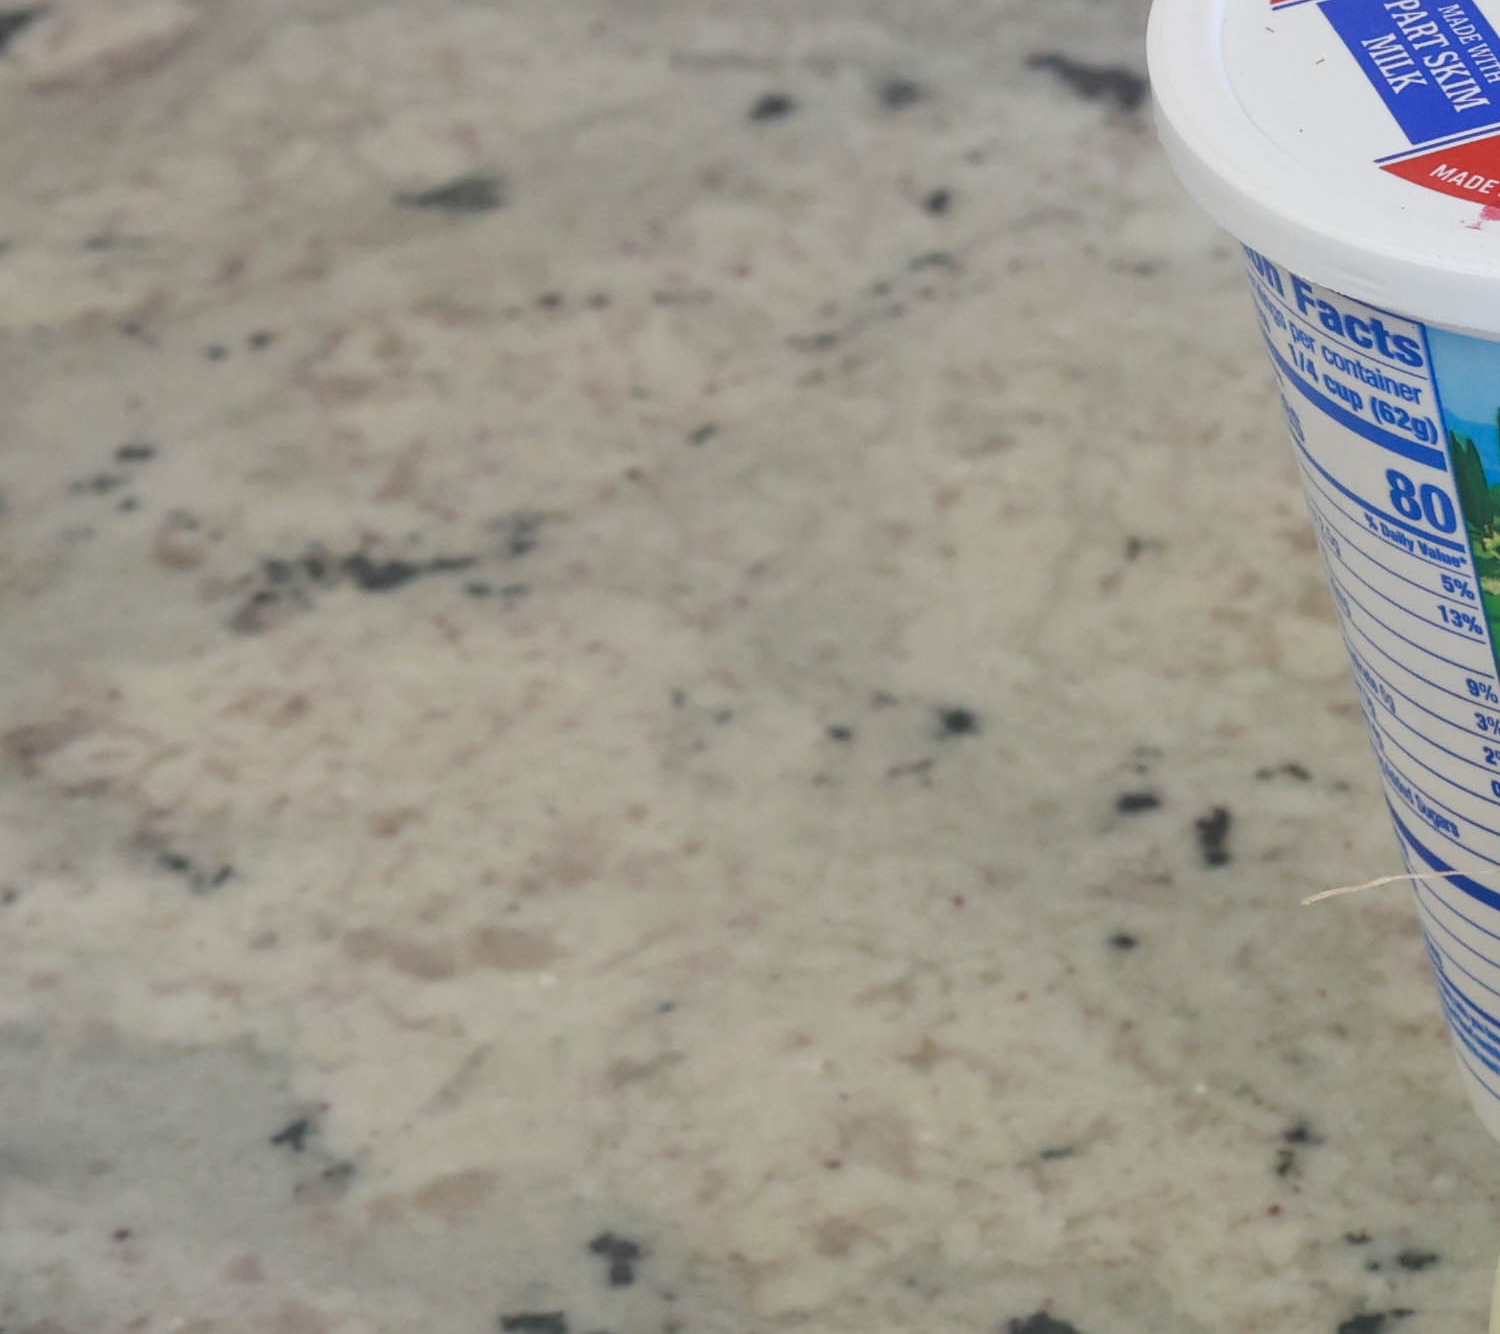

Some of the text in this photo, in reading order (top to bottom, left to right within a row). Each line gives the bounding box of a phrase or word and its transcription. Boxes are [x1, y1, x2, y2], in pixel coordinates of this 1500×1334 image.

[1437, 3, 1480, 49] MADE
[1360, 32, 1428, 95] MILK
[1423, 50, 1491, 114] SKIM
[1429, 163, 1500, 195] MADE
[1289, 273, 1425, 368] Facts
[1320, 344, 1424, 406] container
[1322, 373, 1364, 413] cup
[1369, 395, 1439, 446] (62g)
[1385, 467, 1458, 536] 80
[1439, 572, 1476, 602] 5%
[1437, 603, 1484, 636] 13%
[1465, 677, 1500, 705] 9%
